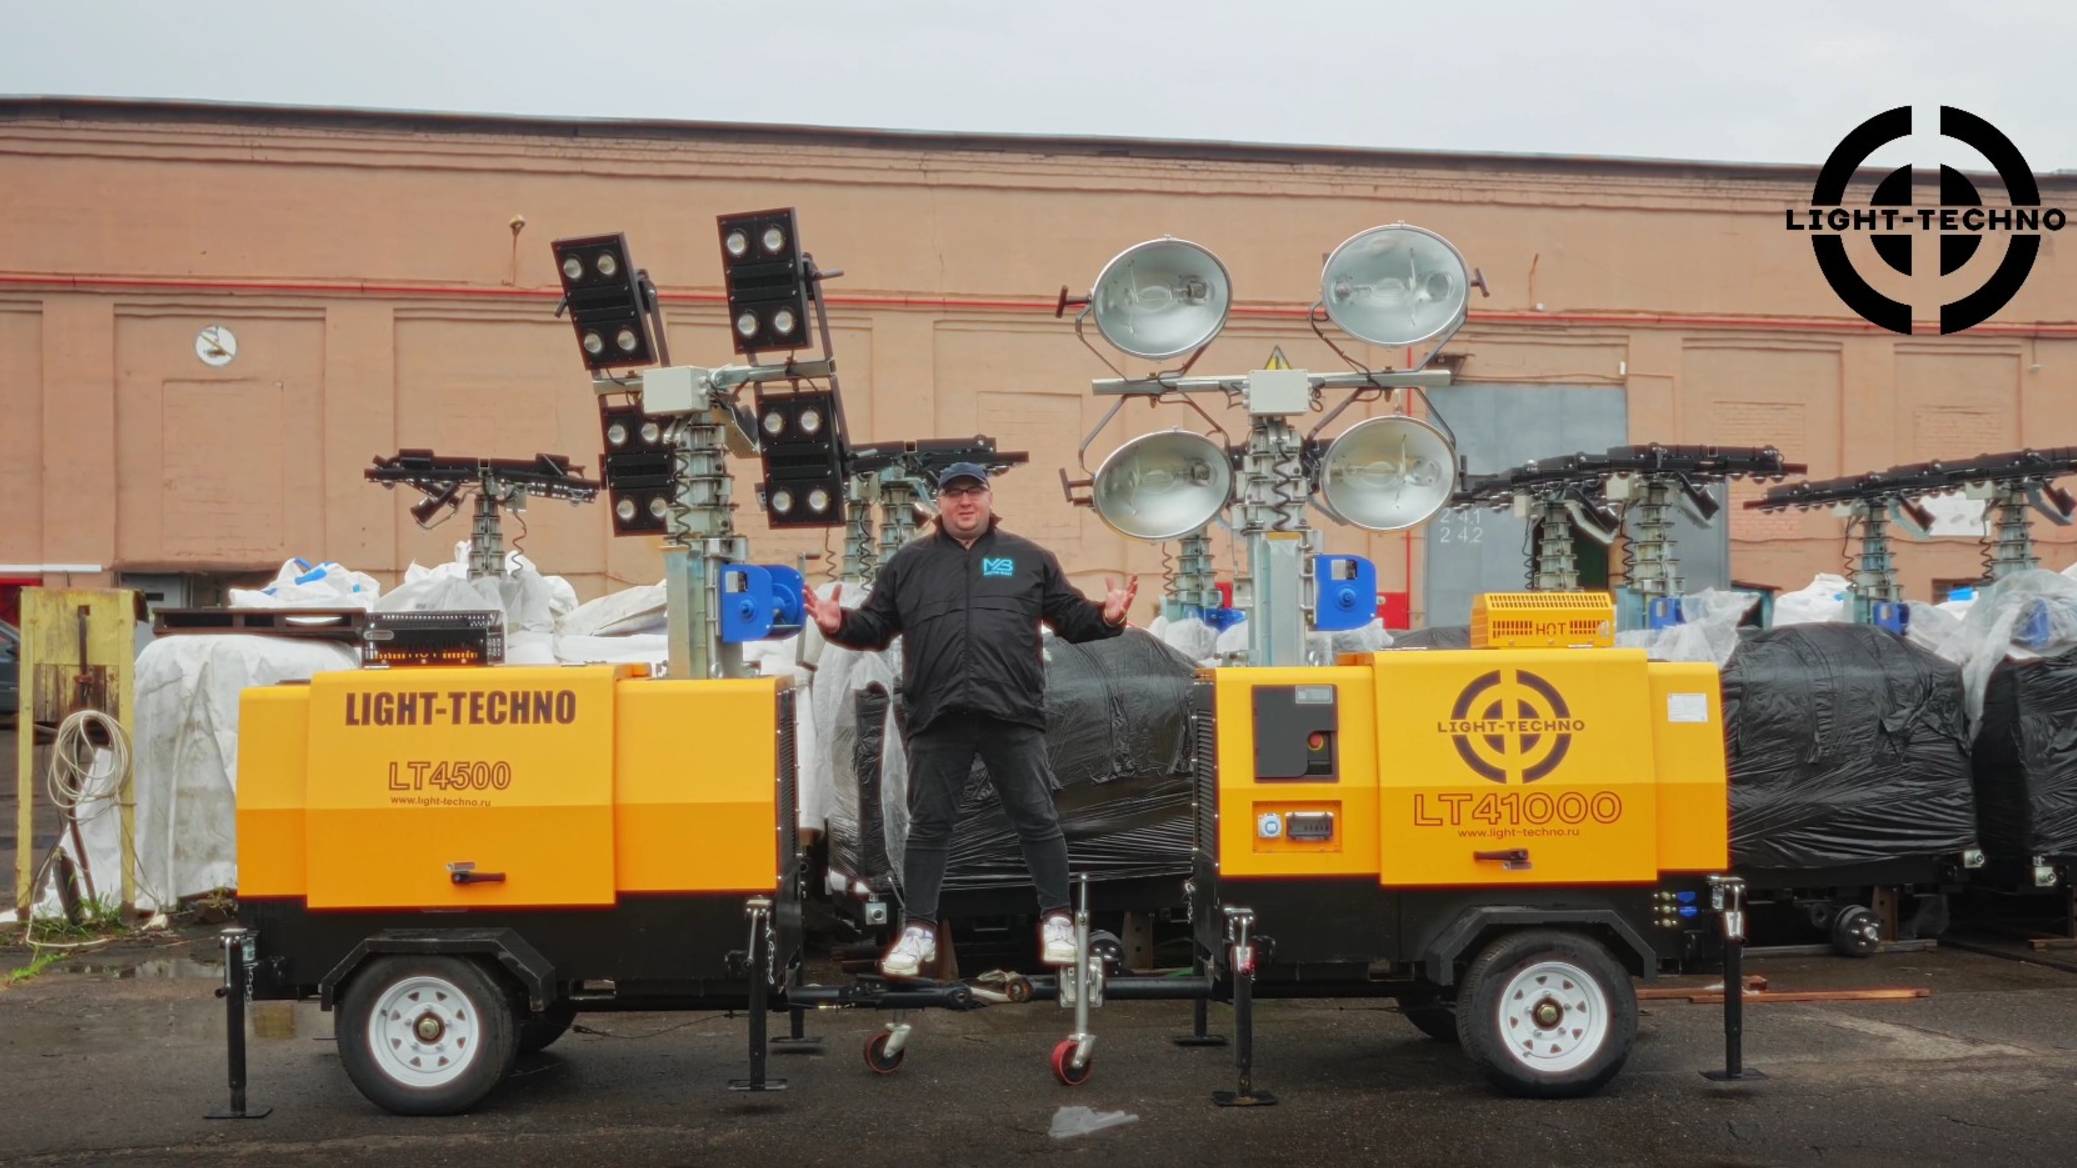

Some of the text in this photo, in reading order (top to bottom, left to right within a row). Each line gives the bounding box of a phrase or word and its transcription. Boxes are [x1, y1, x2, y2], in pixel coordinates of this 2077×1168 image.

[1536, 622, 1567, 636] HOT
[346, 691, 577, 726] LIGHT-TECHNO
[1437, 719, 1585, 733] LIGHT-TECHNO
[388, 761, 511, 791] LT4500
[391, 796, 491, 807] www.light-techno.ru
[1414, 791, 1622, 826] LT41000
[1458, 827, 1580, 839] www.light-techno.ru
